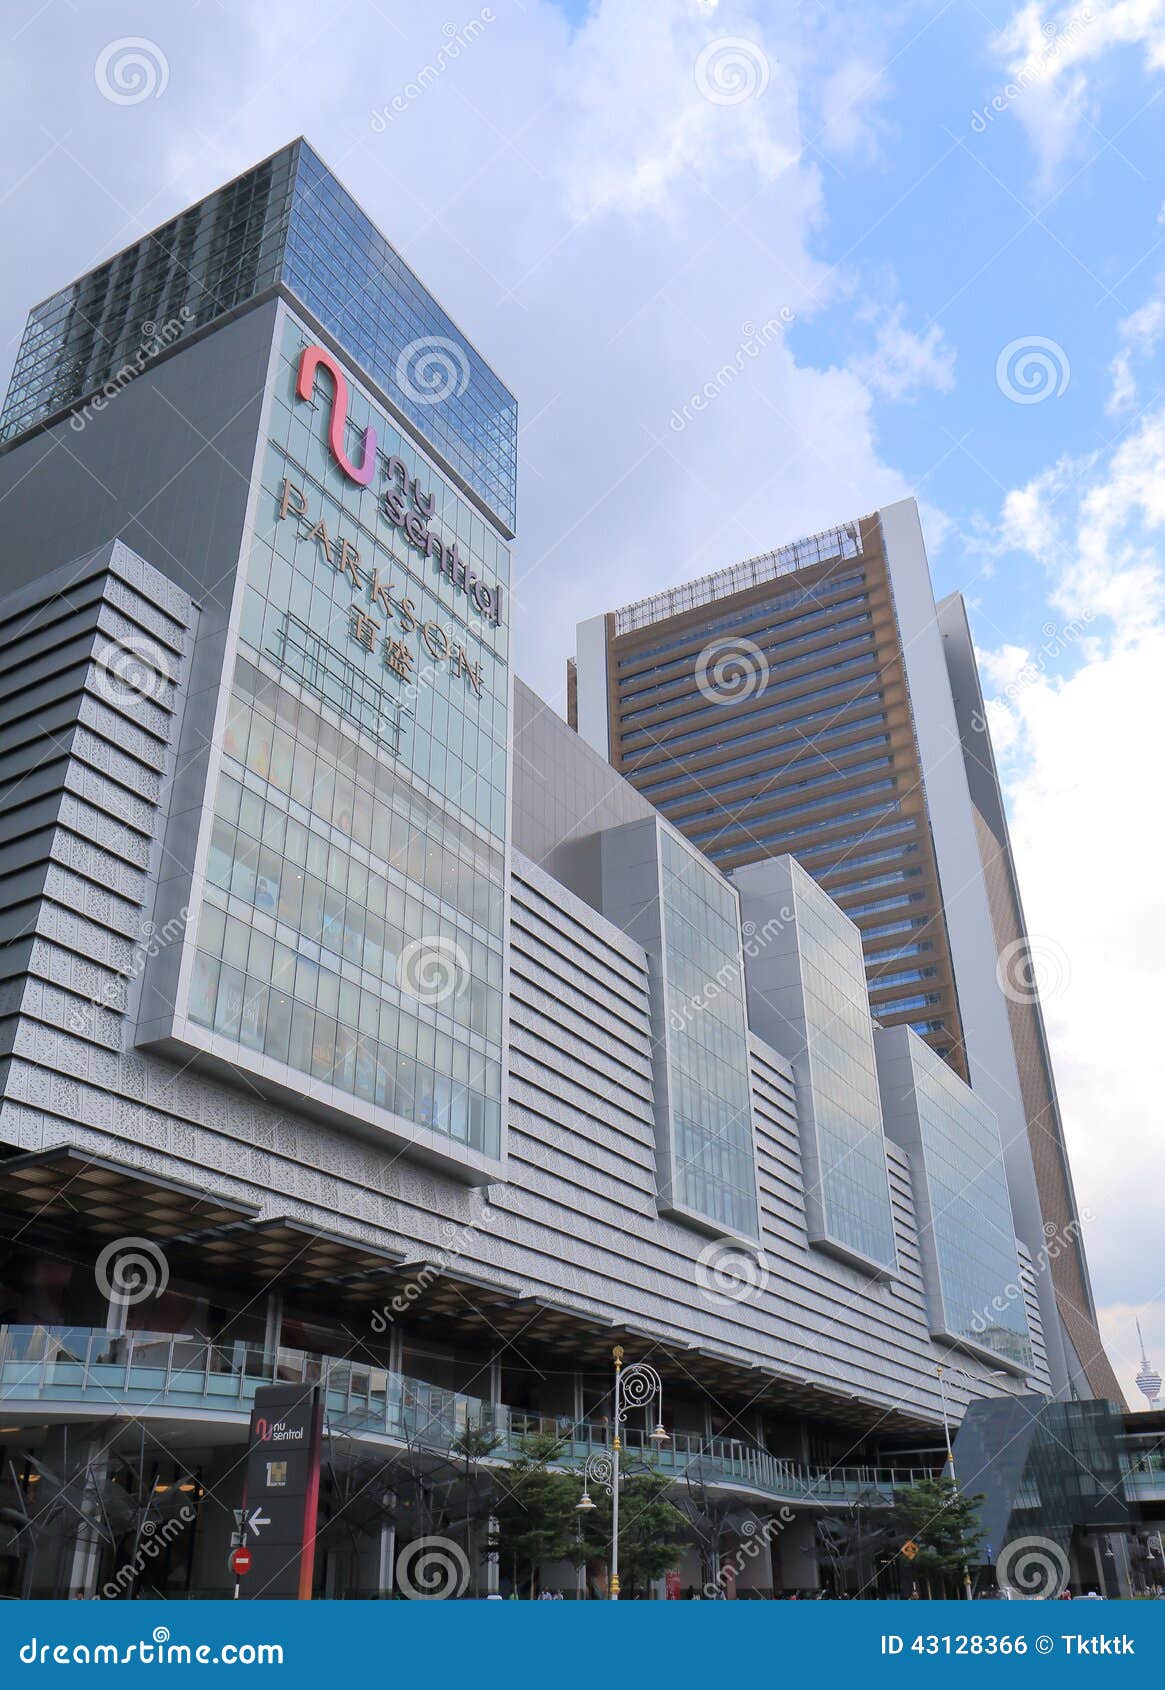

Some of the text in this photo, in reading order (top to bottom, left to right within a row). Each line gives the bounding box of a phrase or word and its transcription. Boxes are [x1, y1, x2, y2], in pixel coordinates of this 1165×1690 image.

[280, 478, 484, 698] PARKSON
[383, 489, 502, 626] sentral
[350, 603, 414, 686] 百盛
[273, 1422, 286, 1432] nu
[273, 1427, 304, 1440] sentral
